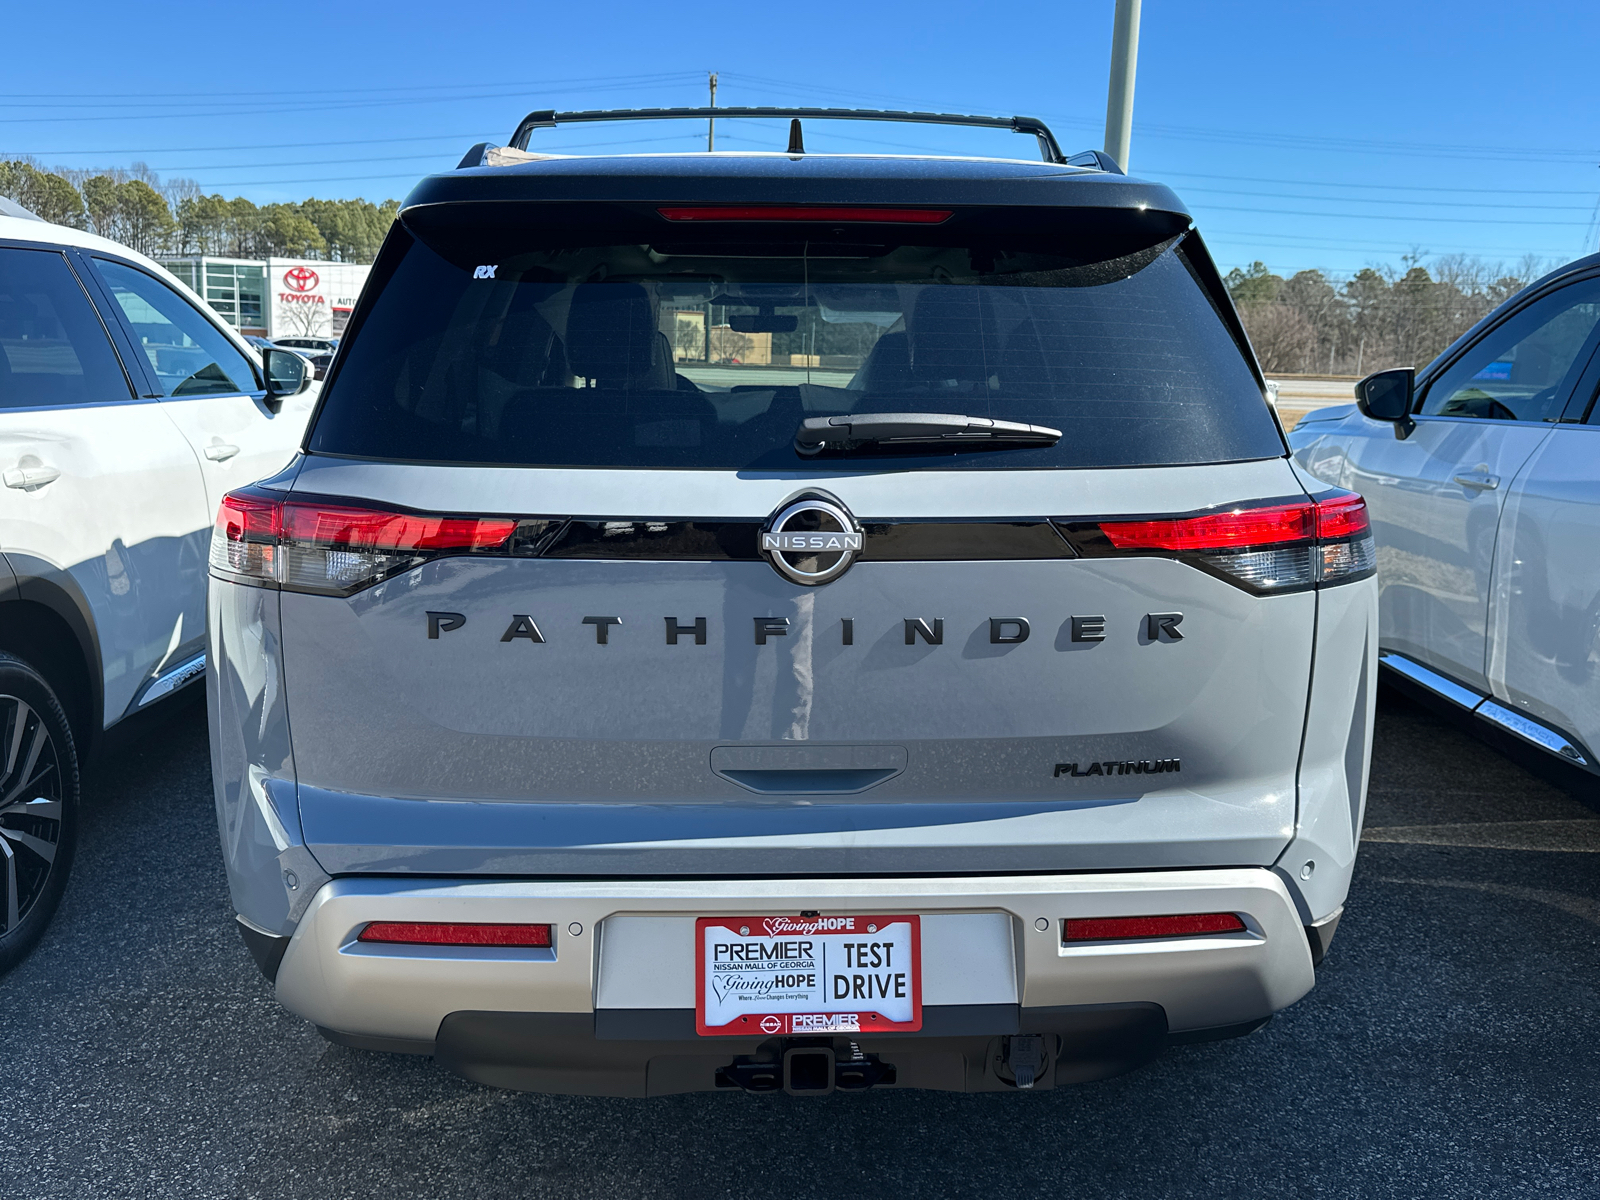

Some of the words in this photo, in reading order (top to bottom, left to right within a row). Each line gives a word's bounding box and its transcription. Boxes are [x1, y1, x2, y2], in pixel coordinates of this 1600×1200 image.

[473, 265, 498, 279] RX
[278, 293, 325, 304] TOYOTA
[765, 536, 859, 549] NISSAN
[425, 610, 1185, 645] PATHFINDER
[47, 697, 81, 806] BRIDGESTONE
[1054, 757, 1181, 778] PLATINUM
[713, 941, 814, 961] PREMIER
[843, 942, 894, 968] TEST
[713, 963, 743, 971] NISSAN
[744, 962, 766, 970] MALL
[779, 961, 815, 969] GEORGIA
[833, 973, 906, 999] DRIVE
[785, 993, 809, 1001] Everything
[792, 1014, 860, 1026] PREMIER
